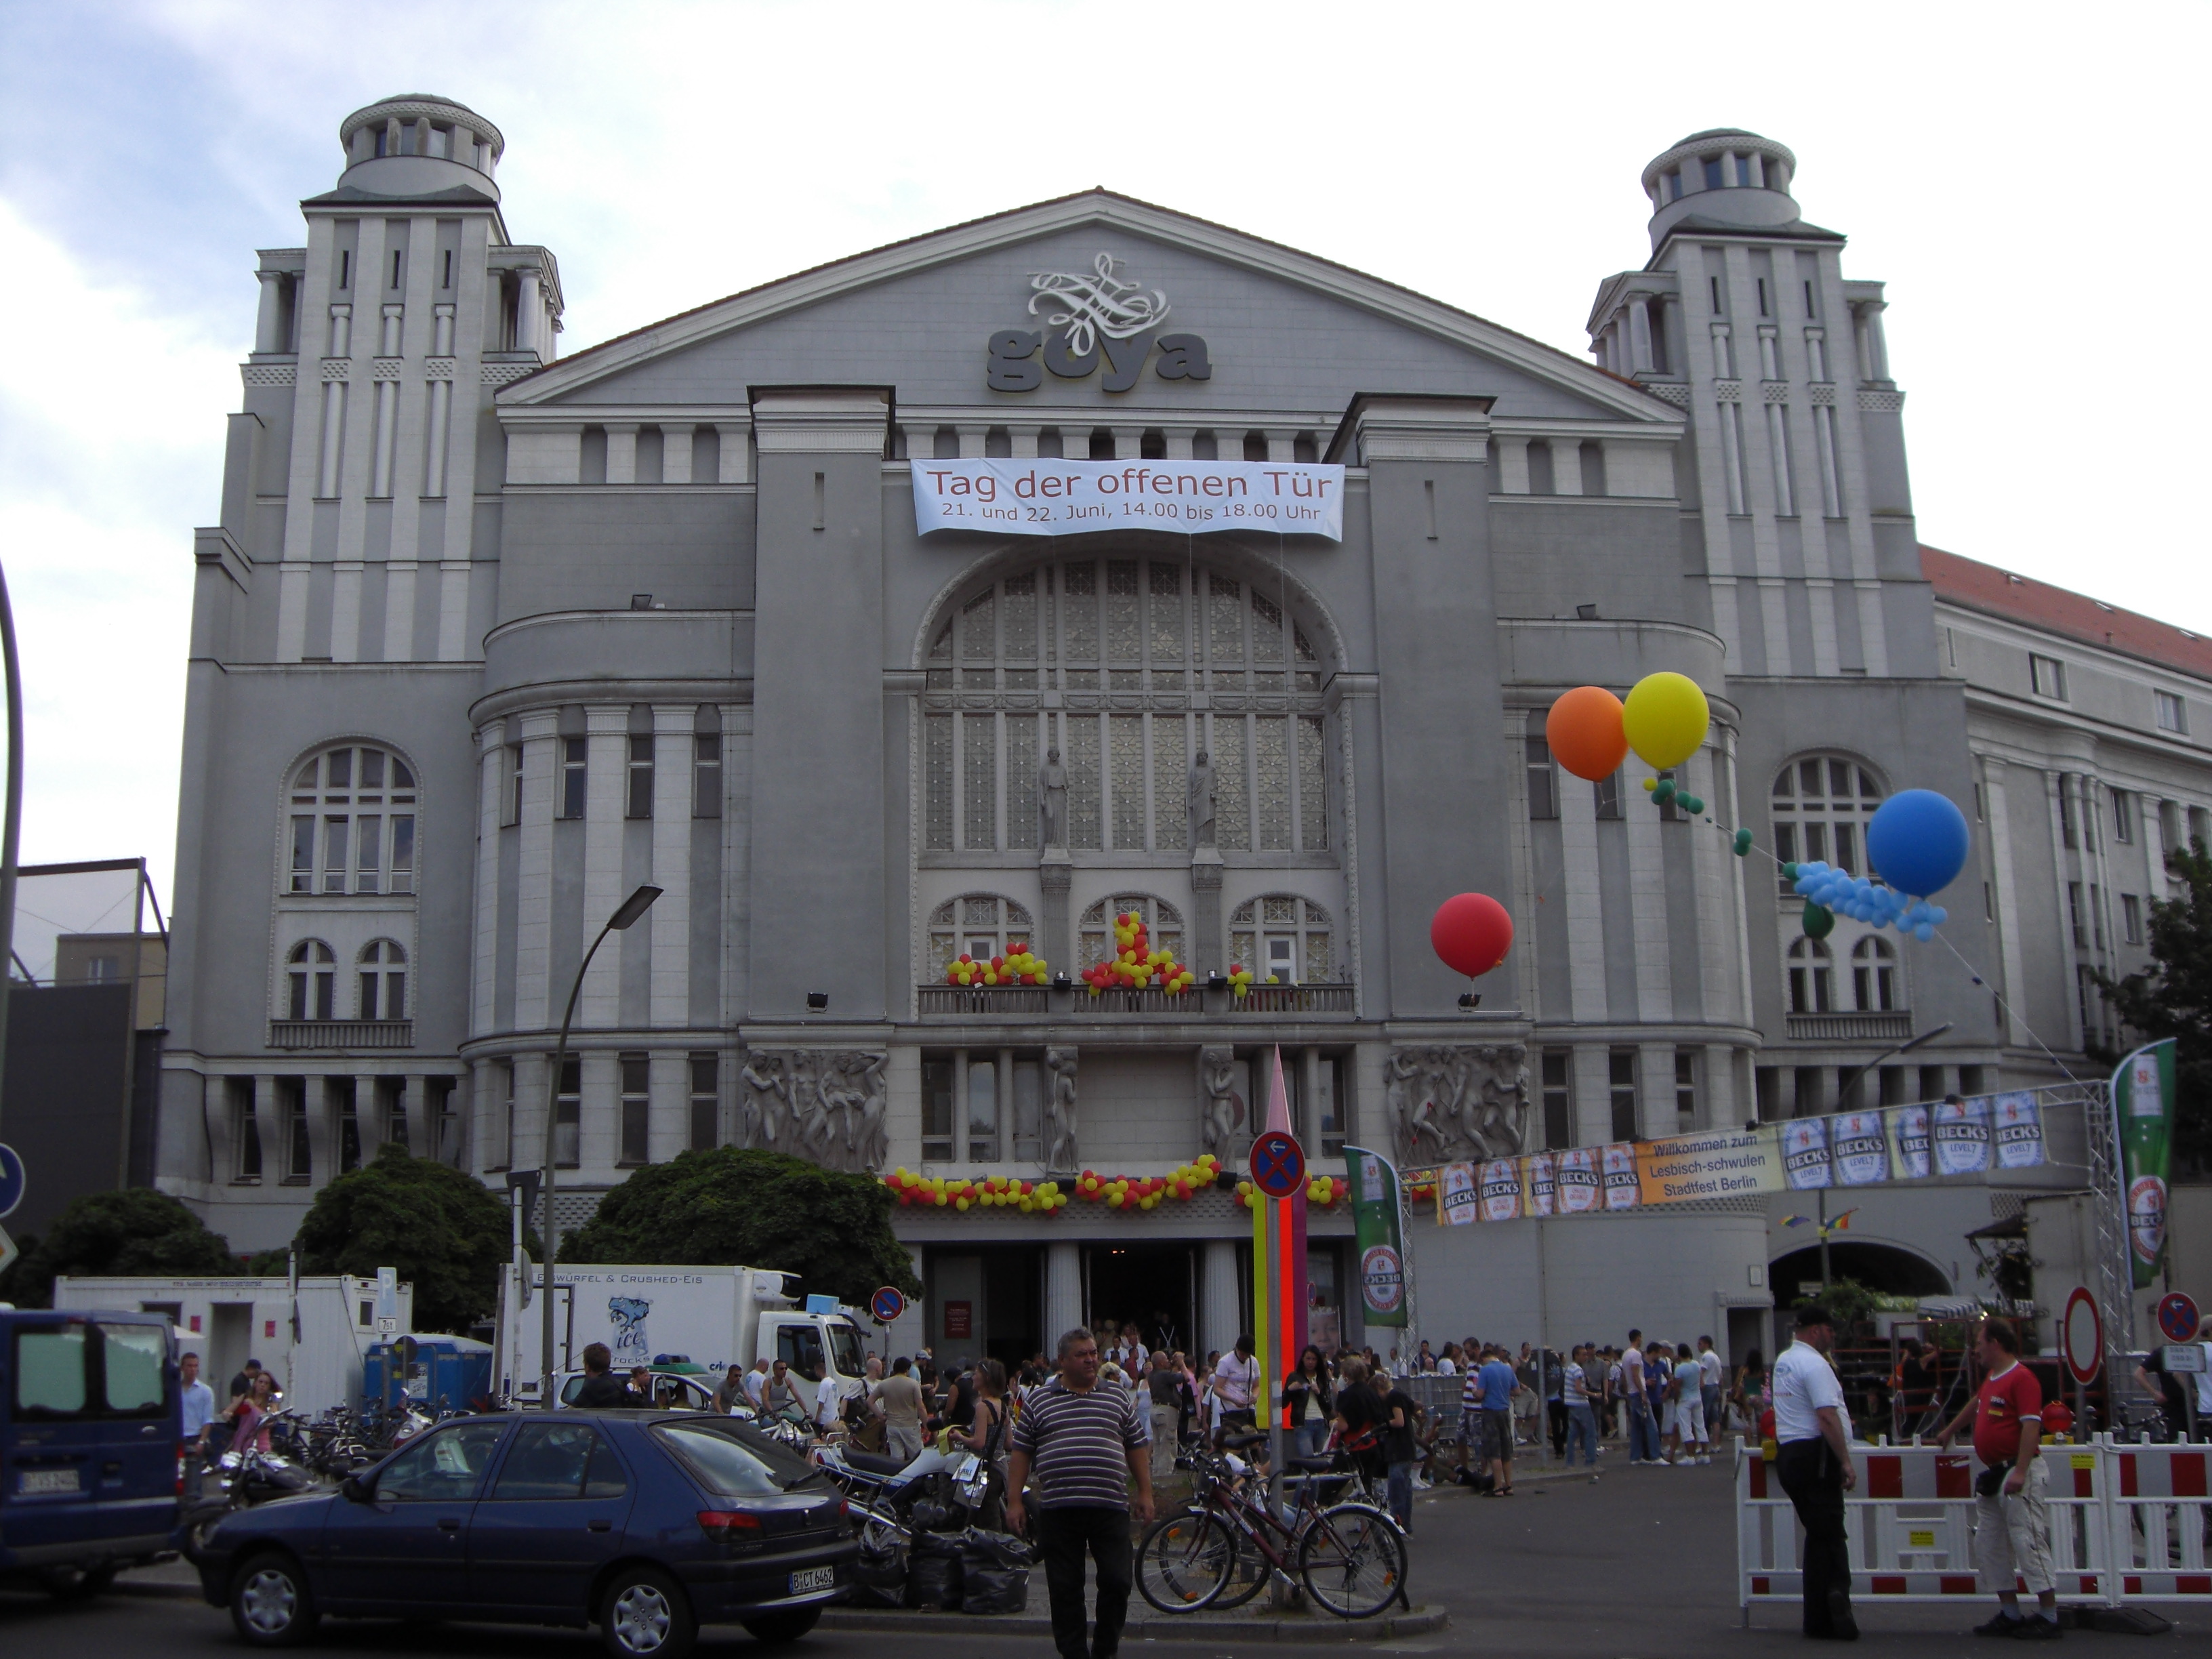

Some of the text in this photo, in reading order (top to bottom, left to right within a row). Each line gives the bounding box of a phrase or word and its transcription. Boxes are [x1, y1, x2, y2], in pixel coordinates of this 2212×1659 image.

[987, 329, 1212, 393] goya
[926, 468, 1332, 503] Tag der offenen Tür
[942, 502, 1321, 522] 21. und 22. Juni, 14.00 bis 18.00 Uhr
[1936, 1125, 1988, 1141] BECK'S
[1654, 1135, 1757, 1157] Willkommen zum
[1837, 1138, 1883, 1155] BECK'S
[1650, 1154, 1765, 1178] Lesbisch-schwulen
[1559, 1172, 1599, 1185] BECK'S
[1664, 1176, 1757, 1197] Stadtfest Berlin
[1482, 1183, 1519, 1197] BECK'S
[382, 1273, 392, 1300] P
[537, 1273, 601, 1283] EWÜRFEL
[793, 1574, 799, 1589] B
[815, 1568, 833, 1585] 6462
